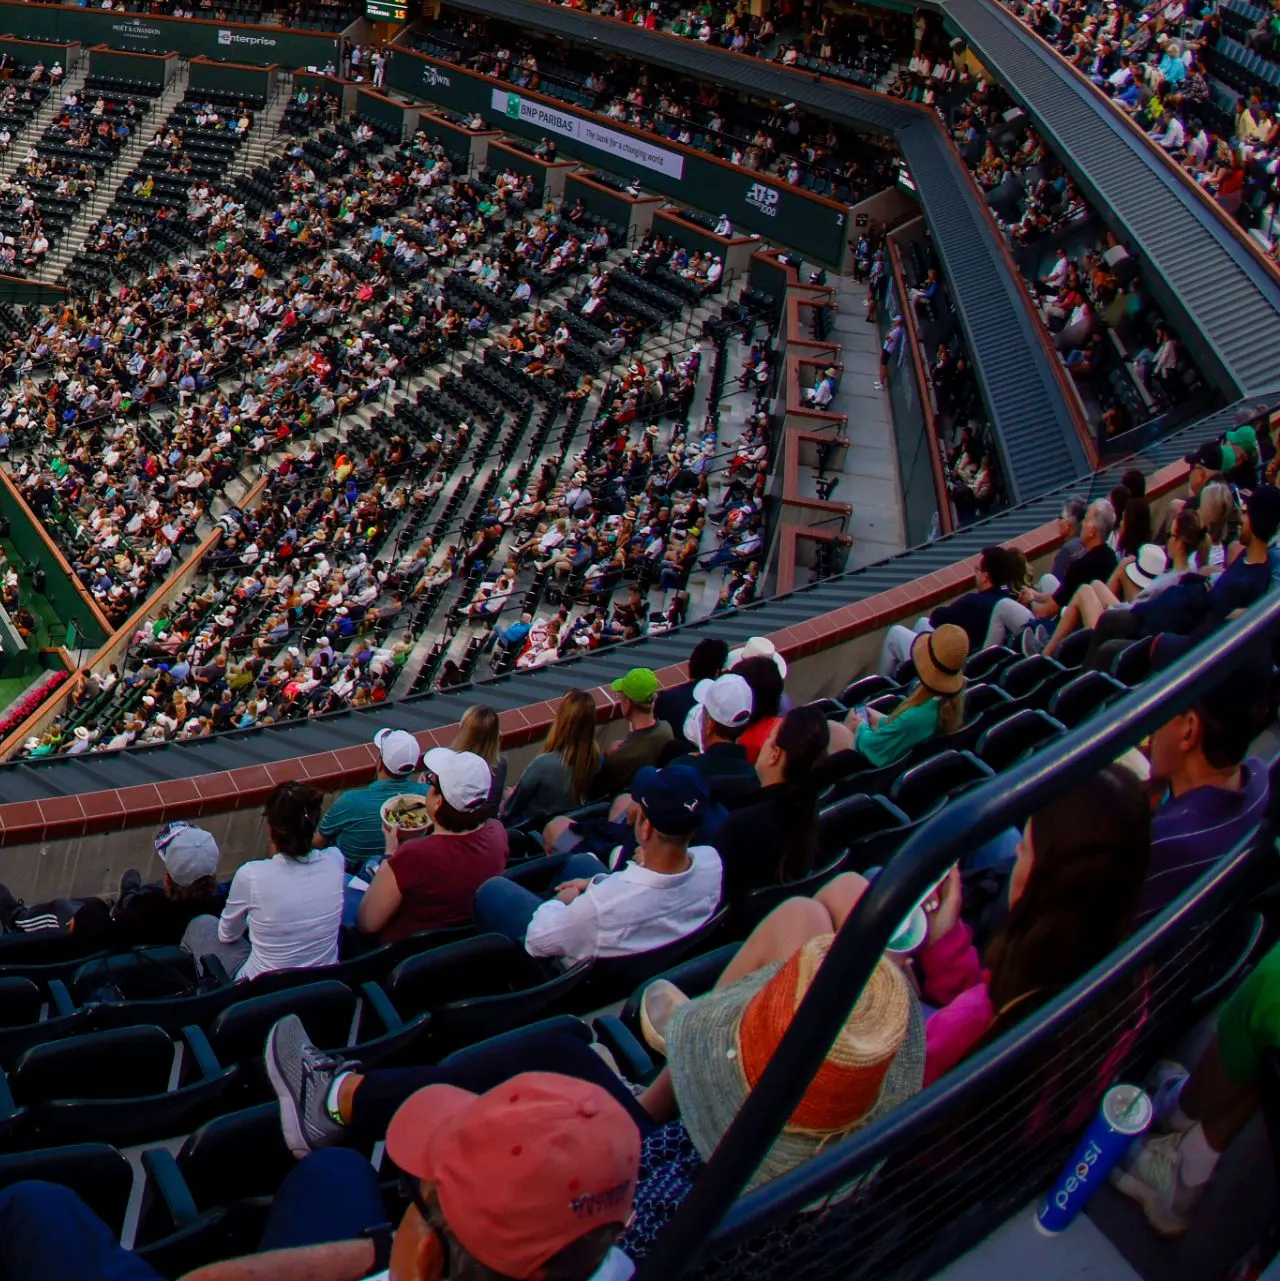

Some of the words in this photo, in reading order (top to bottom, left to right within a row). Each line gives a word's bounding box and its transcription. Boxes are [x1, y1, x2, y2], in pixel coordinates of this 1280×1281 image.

[394, 10, 406, 19] 15
[219, 30, 276, 47] enterprise
[521, 104, 537, 117] BNP
[539, 111, 573, 132] PARIBAS
[586, 129, 595, 138] The
[595, 132, 609, 144] bank
[608, 136, 617, 148] for
[622, 142, 647, 161] changing
[647, 153, 664, 166] world
[746, 183, 780, 205] ATP
[760, 203, 776, 216] 1000
[836, 214, 844, 226] 2
[1055, 1140, 1102, 1210] pepsi
